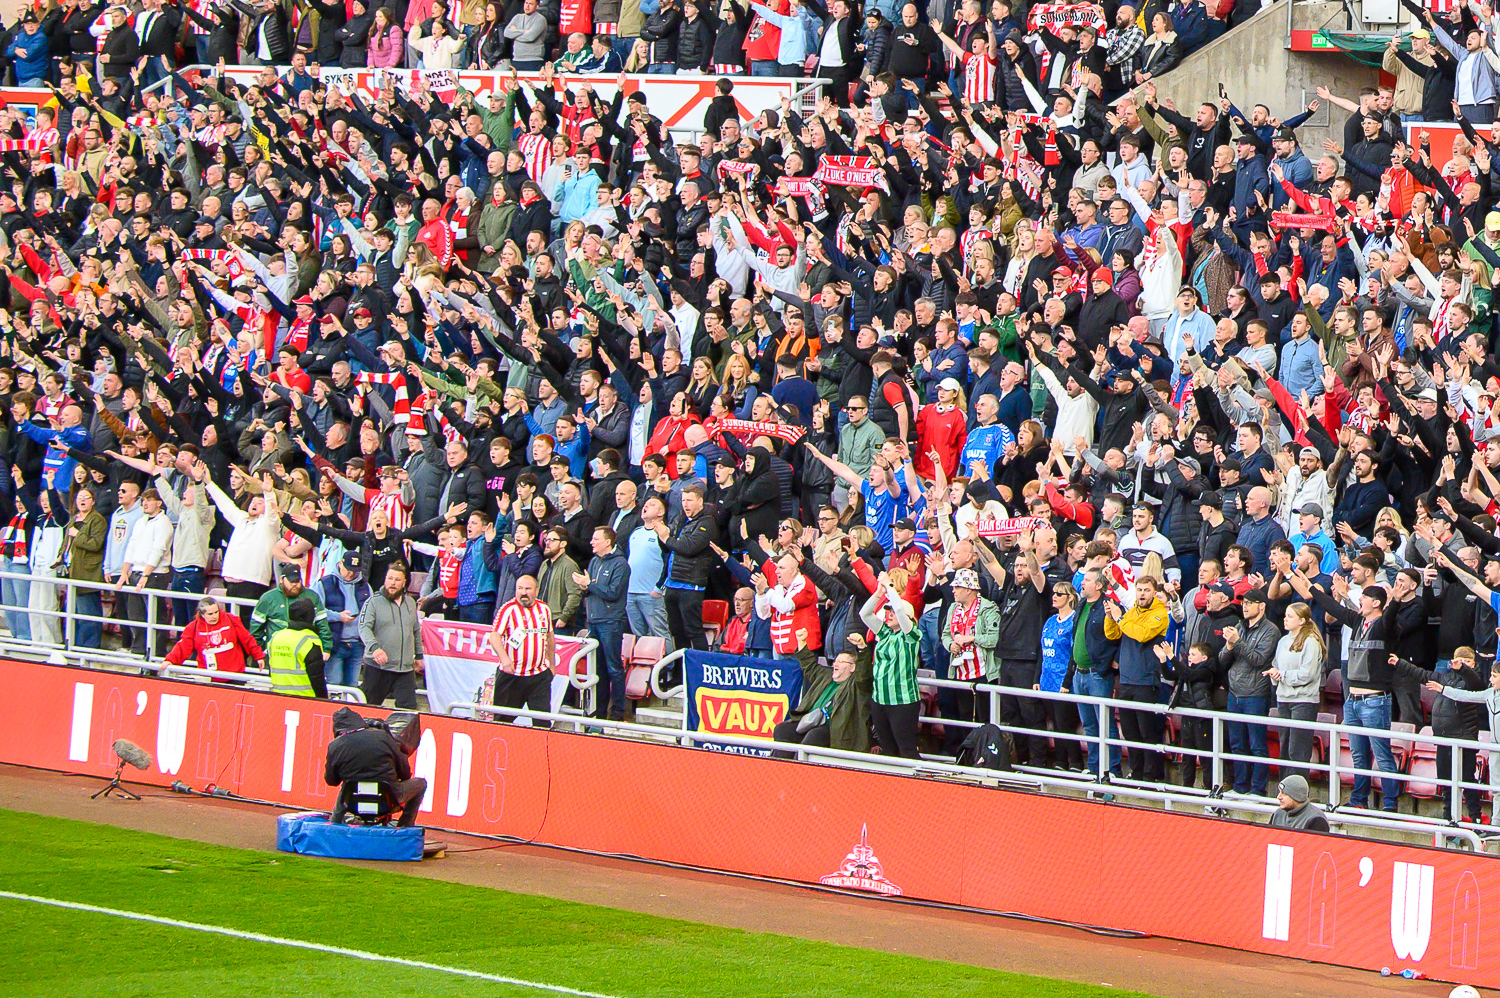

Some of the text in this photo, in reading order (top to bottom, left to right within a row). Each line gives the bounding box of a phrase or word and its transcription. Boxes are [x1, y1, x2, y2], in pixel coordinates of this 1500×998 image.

[1040, 11, 1098, 25] SUNDERLAND
[825, 169, 844, 182] LUKE
[722, 419, 776, 432] SUNDERLAND
[702, 664, 782, 690] BREWERS
[706, 702, 783, 733] VAUX
[415, 730, 508, 823] ADS
